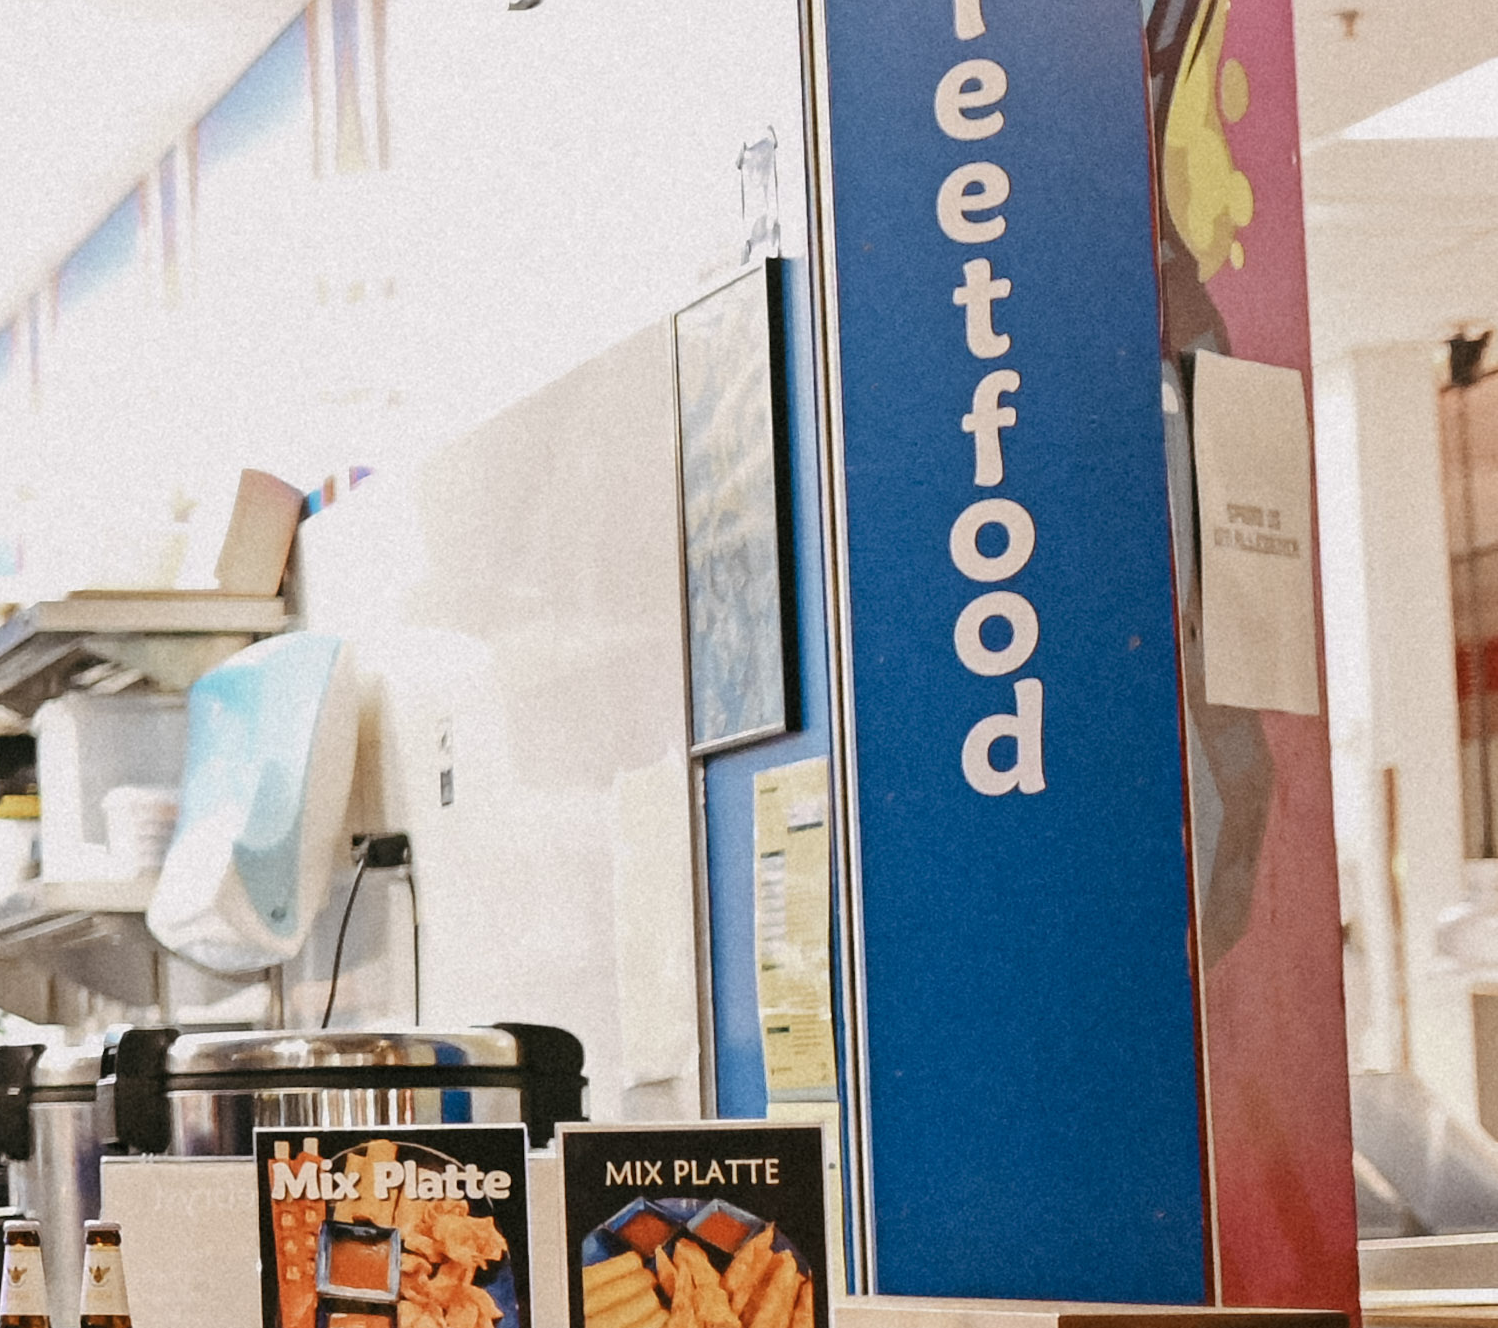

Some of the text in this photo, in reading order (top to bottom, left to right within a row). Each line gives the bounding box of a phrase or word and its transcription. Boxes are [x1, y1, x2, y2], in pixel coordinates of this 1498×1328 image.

[271, 1159, 361, 1202] Mix
[373, 1159, 512, 1202] Platte
[604, 1158, 780, 1189] MIX PLATTE
